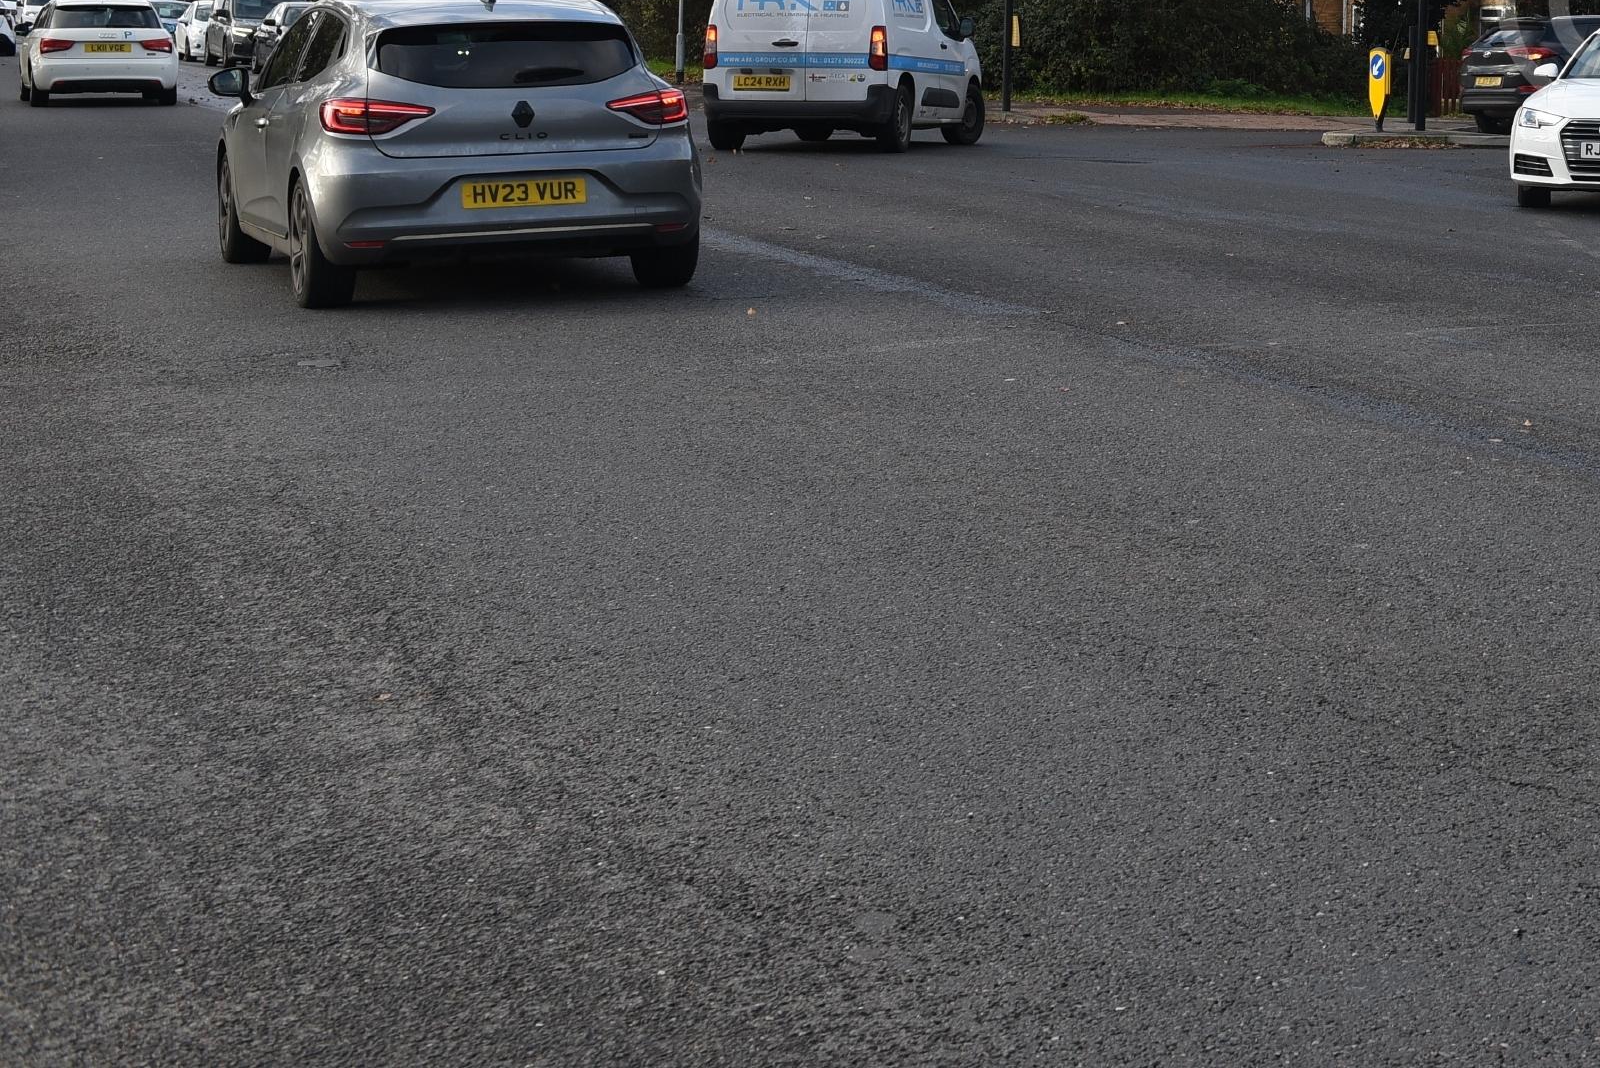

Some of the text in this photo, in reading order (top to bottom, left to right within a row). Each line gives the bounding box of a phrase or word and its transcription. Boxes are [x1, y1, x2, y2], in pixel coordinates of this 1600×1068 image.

[737, 77, 785, 87] LC24 RXH
[500, 132, 548, 140] CLIO
[473, 181, 576, 203] HV23 VUR
